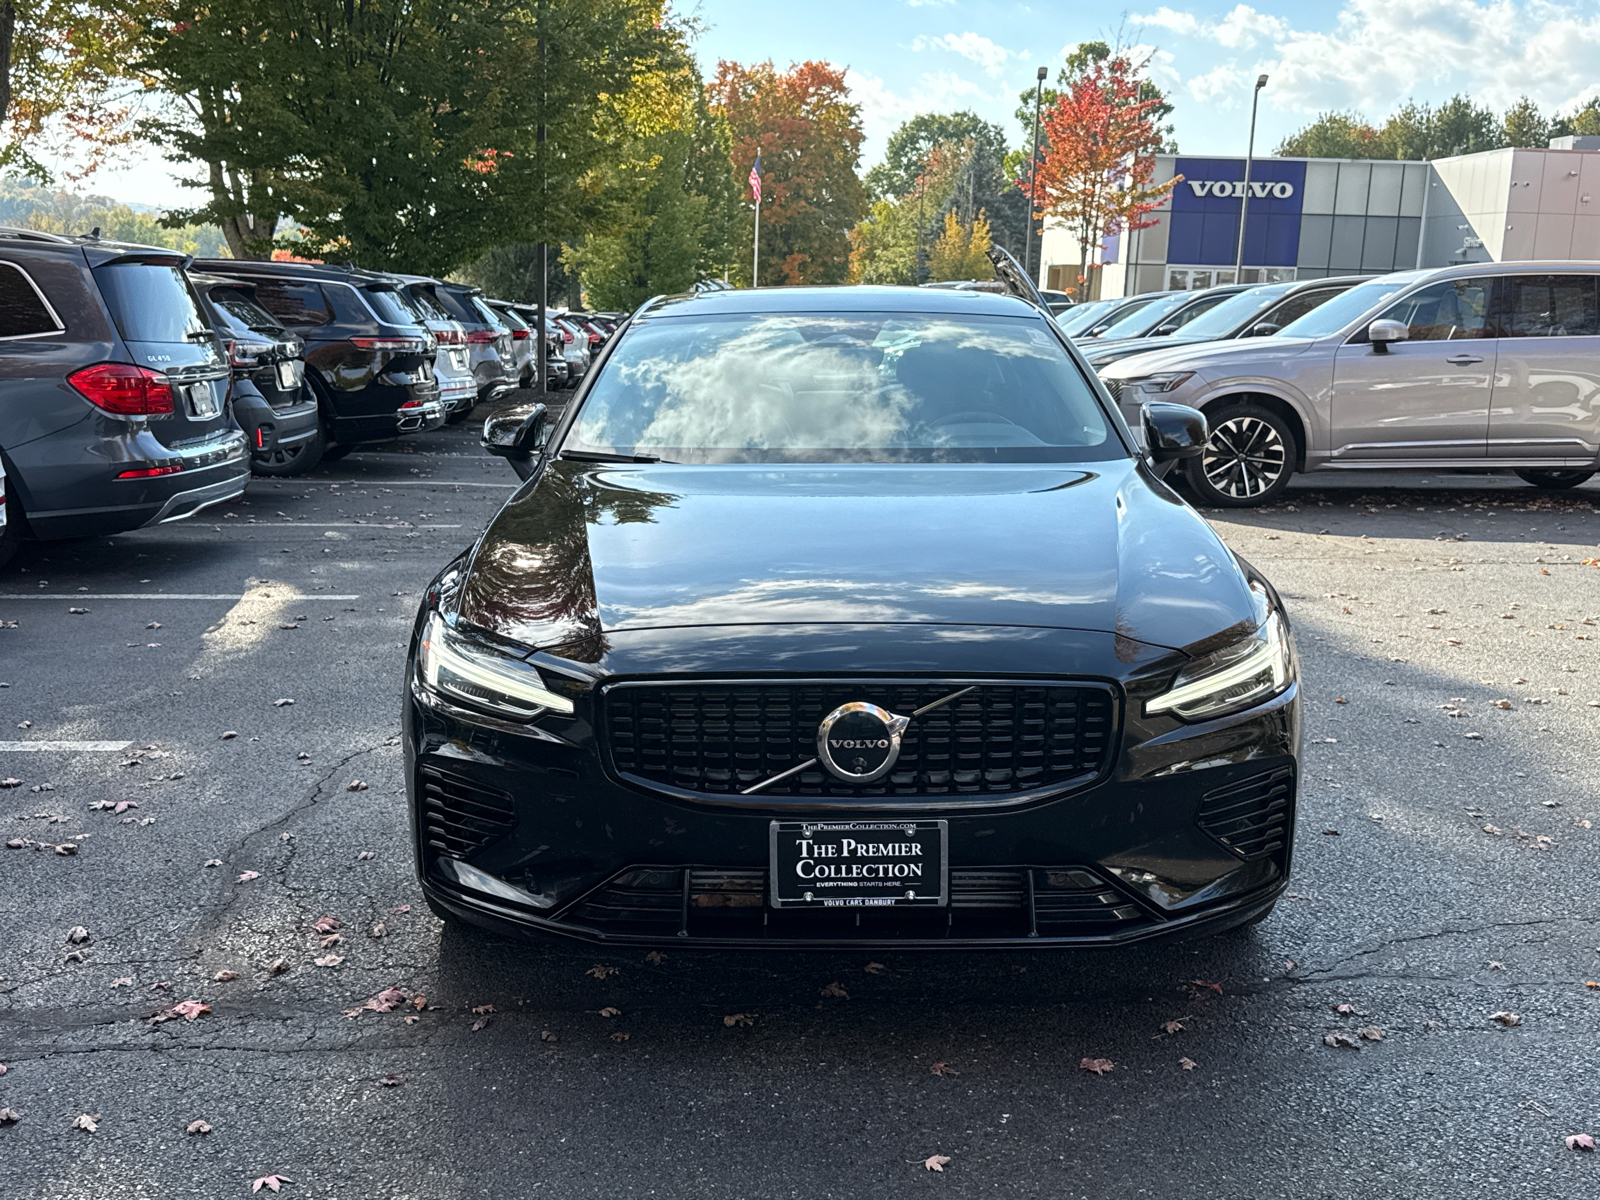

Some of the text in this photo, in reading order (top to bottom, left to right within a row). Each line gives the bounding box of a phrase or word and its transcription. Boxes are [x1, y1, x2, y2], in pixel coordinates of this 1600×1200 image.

[1187, 180, 1294, 199] VOLVO
[829, 739, 889, 749] VOLVO
[795, 838, 923, 858] THE PREMIER
[796, 859, 923, 879] COLLECTION
